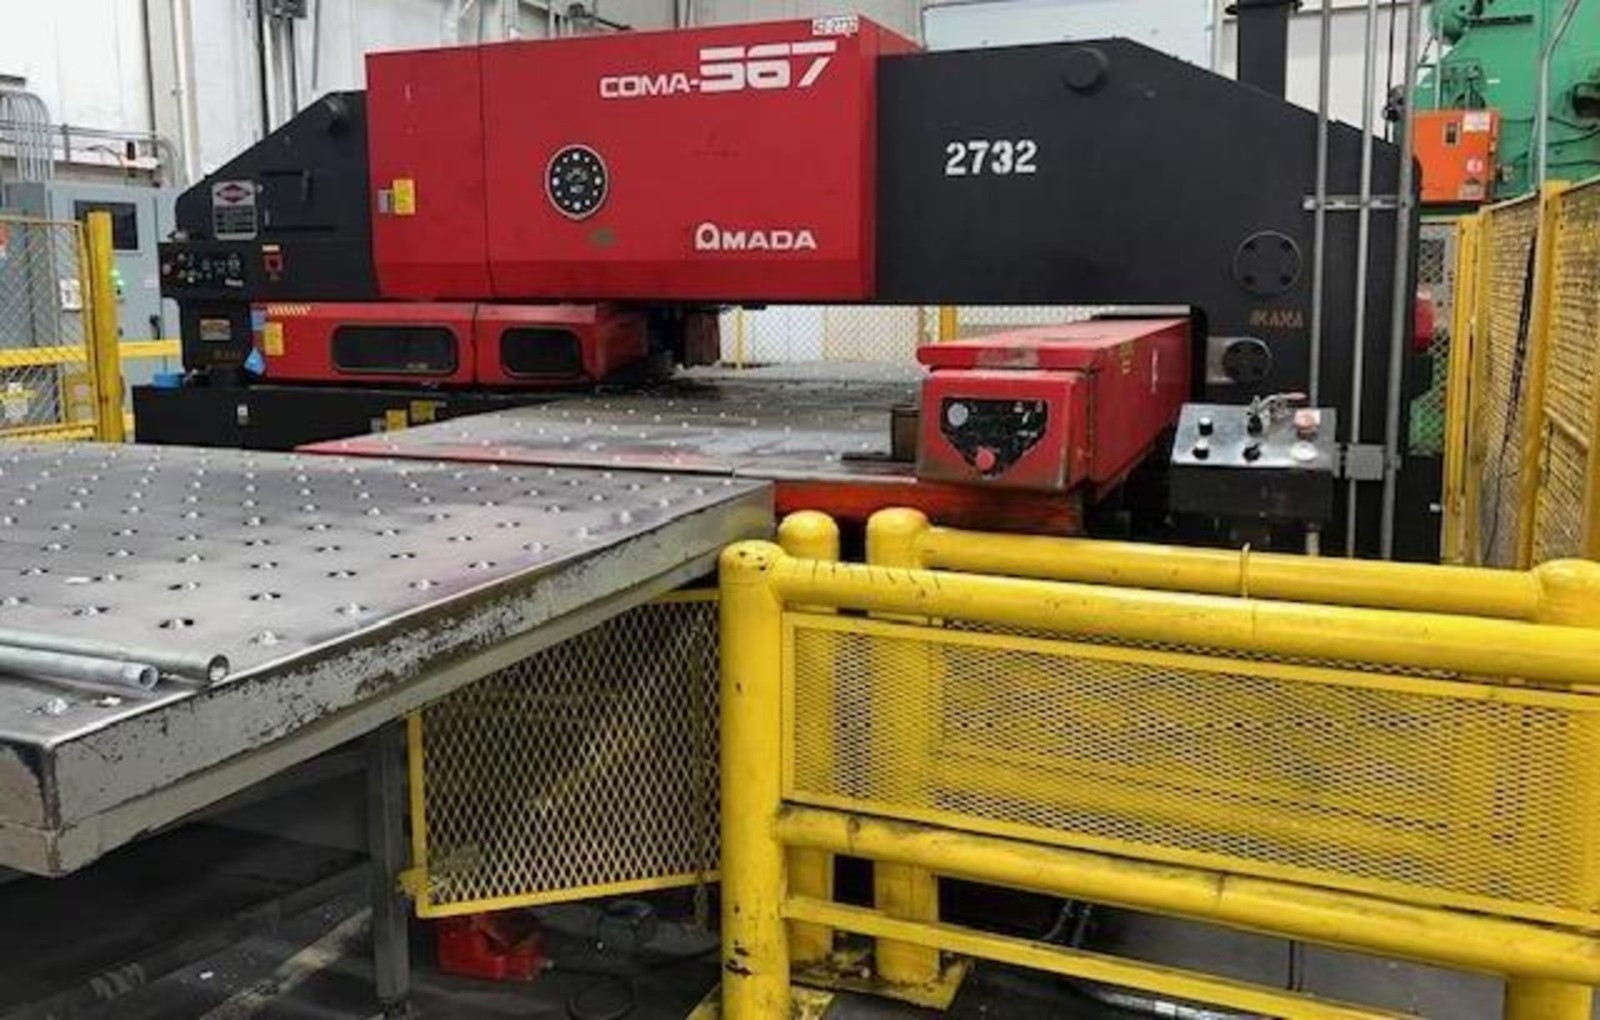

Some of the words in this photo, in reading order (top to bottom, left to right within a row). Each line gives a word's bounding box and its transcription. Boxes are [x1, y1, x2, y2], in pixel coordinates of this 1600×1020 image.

[600, 40, 837, 98] COMA-567
[945, 139, 1038, 175] 2732
[695, 222, 818, 251] AMADA
